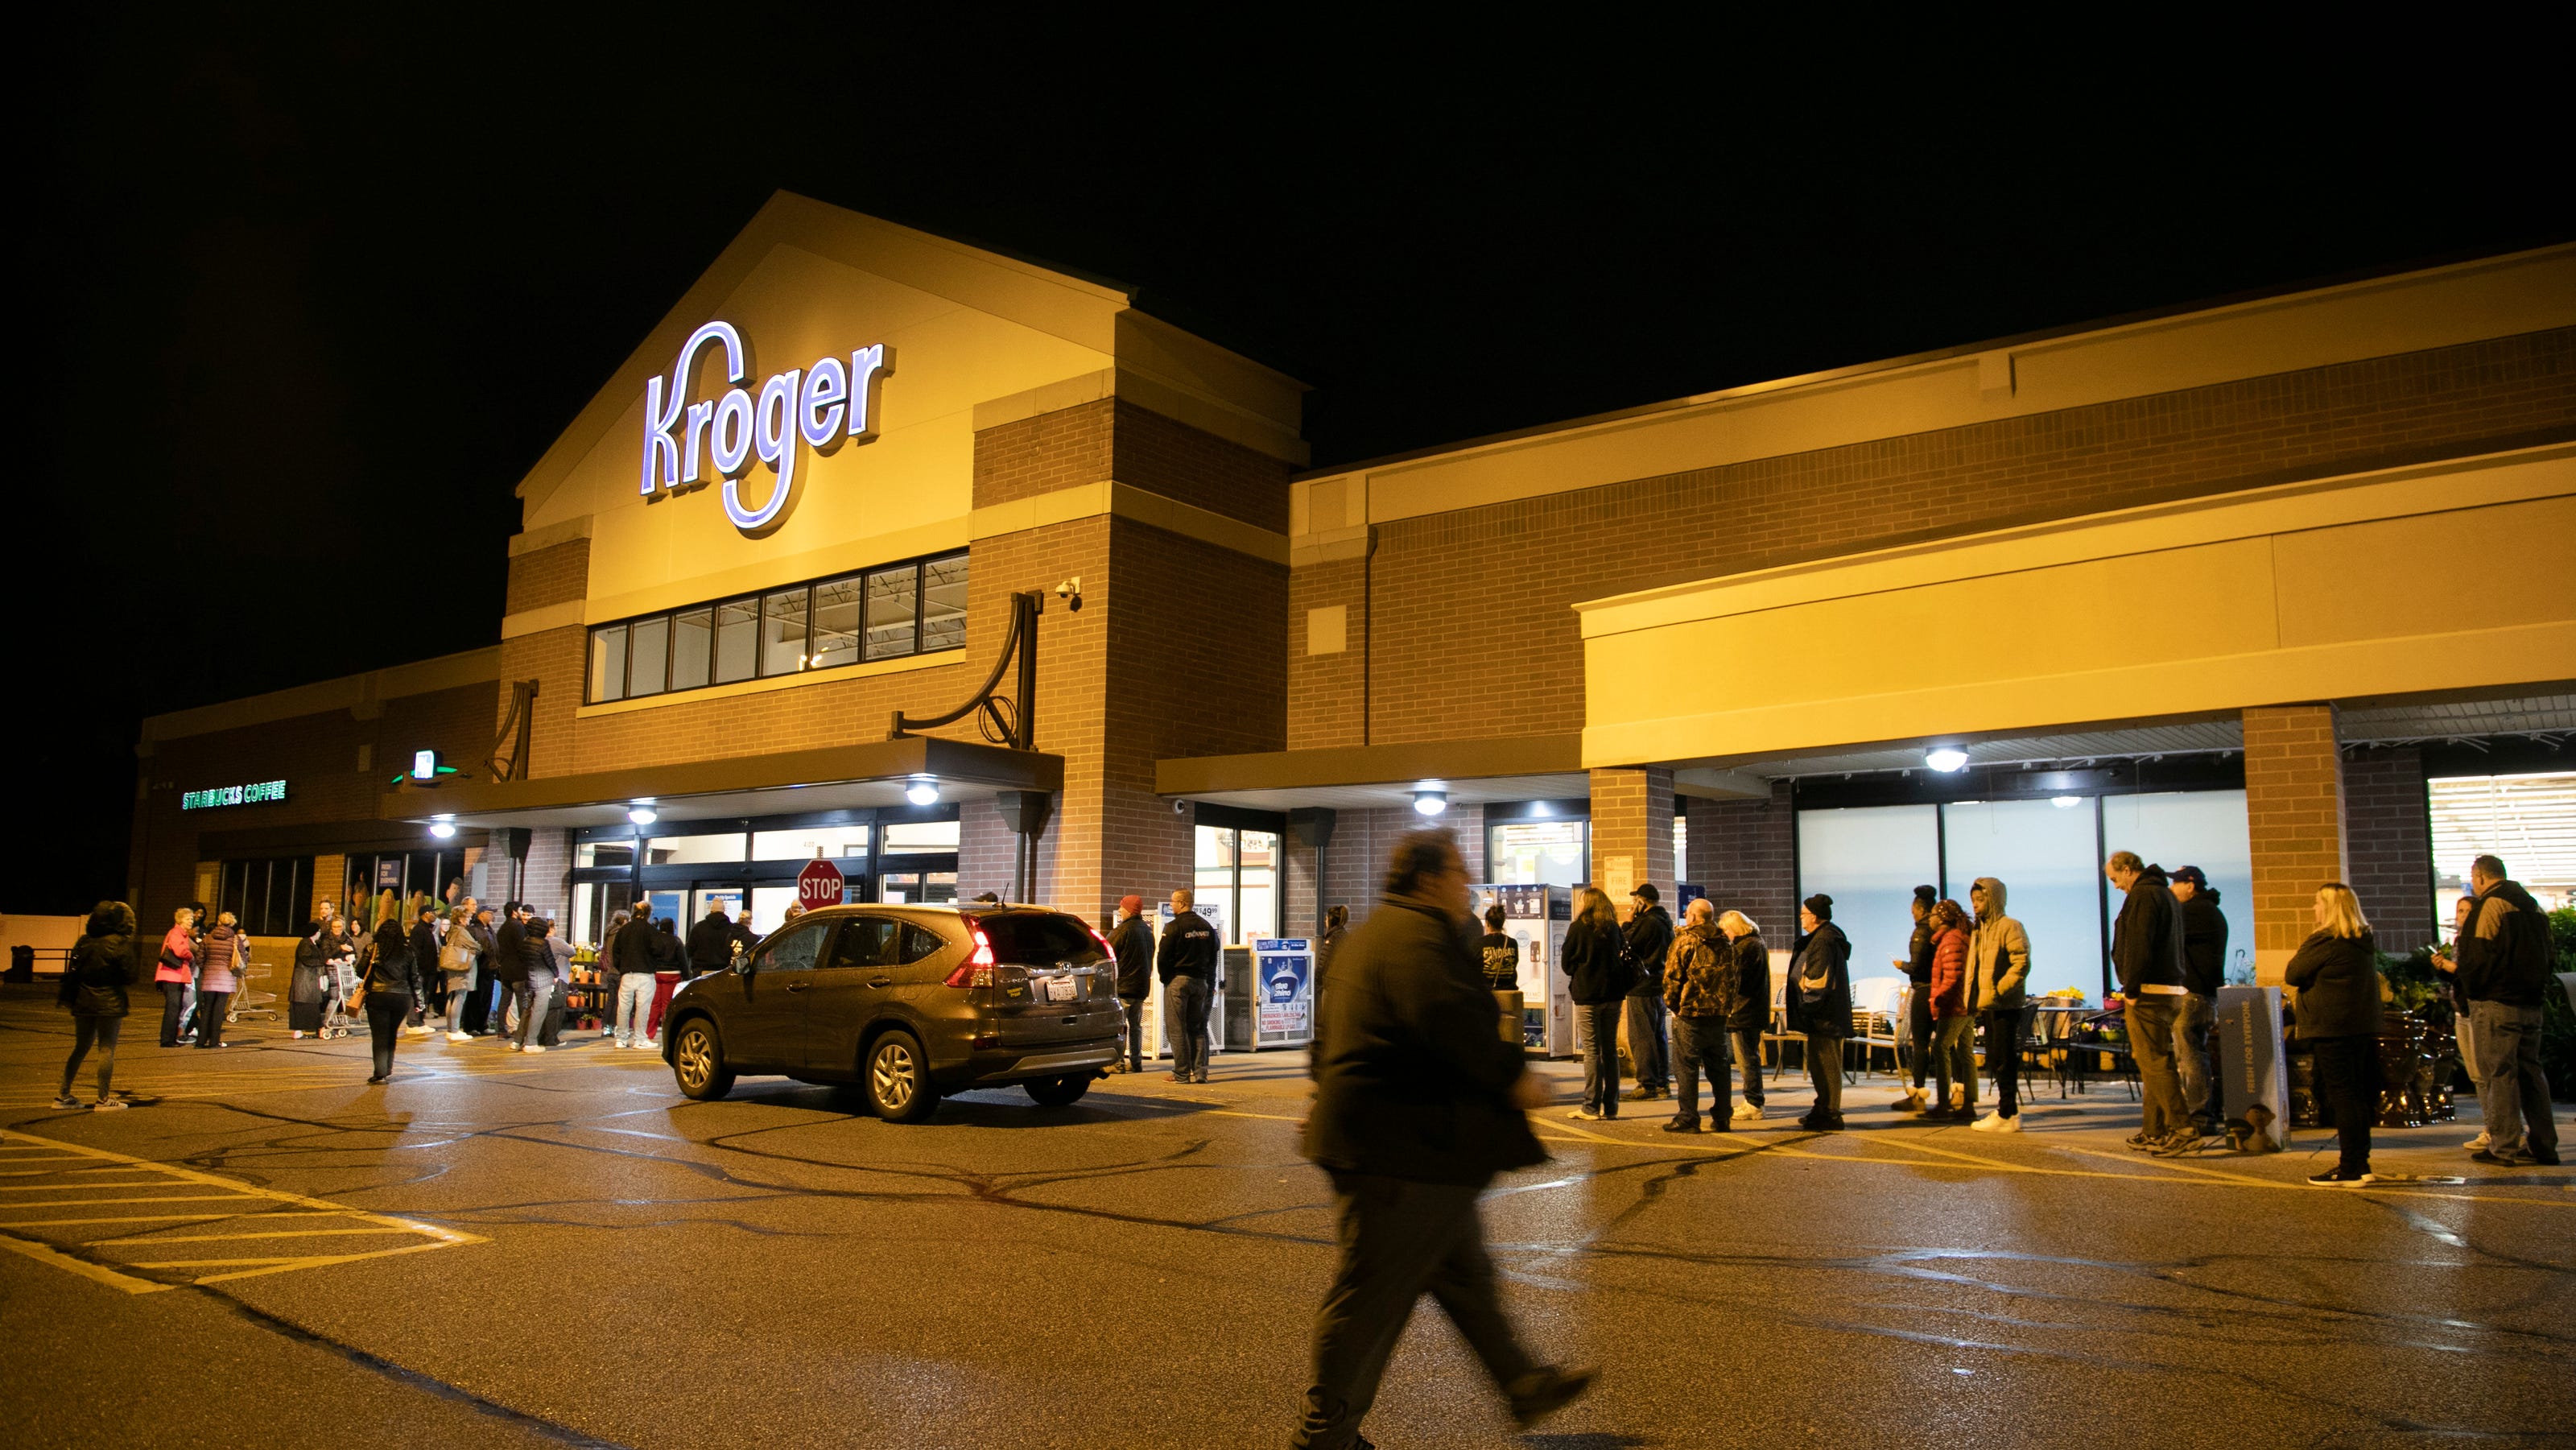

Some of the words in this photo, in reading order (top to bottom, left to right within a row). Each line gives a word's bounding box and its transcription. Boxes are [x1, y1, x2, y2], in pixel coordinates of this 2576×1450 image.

[640, 320, 884, 529] Kroger
[182, 786, 243, 810] STARBUCKS
[244, 779, 286, 803] COFFEE
[801, 878, 841, 899] STOP
[1610, 888, 1629, 897] LANE
[1611, 876, 1628, 885] FIRE
[2241, 1000, 2252, 1044] EVERYONE
[2244, 1046, 2253, 1064] FOR
[2246, 1066, 2255, 1093] FRESH
